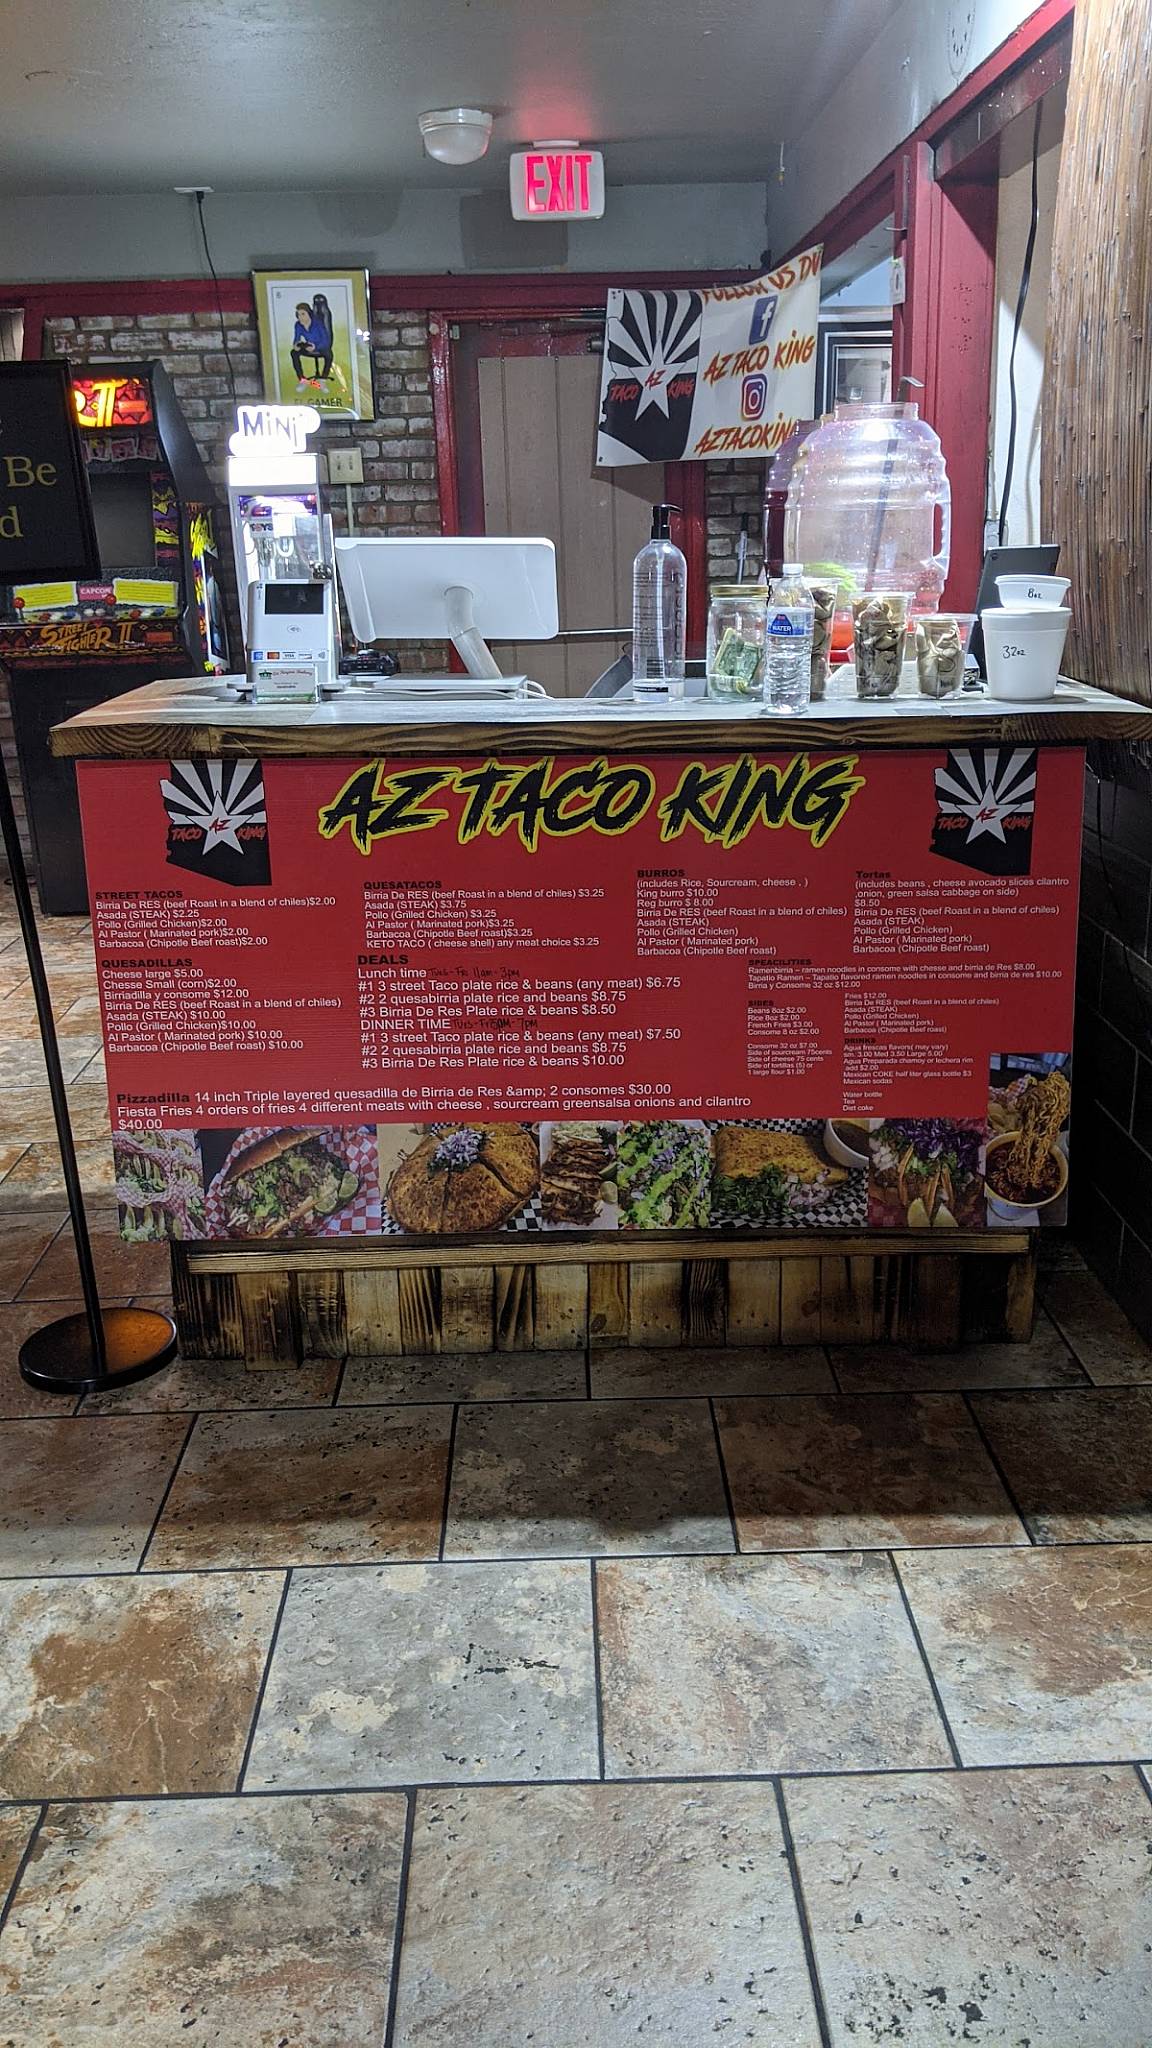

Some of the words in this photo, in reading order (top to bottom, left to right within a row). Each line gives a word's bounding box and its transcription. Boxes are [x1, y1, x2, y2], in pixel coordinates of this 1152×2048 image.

[526, 155, 593, 212] EXIT
[768, 266, 796, 290] US
[703, 352, 732, 387] AZ
[731, 345, 769, 378] TACO
[772, 330, 816, 372] KING
[644, 370, 665, 390] AZ
[610, 383, 639, 401] TACO
[667, 379, 694, 399] KING
[307, 397, 343, 407] GAMER
[694, 413, 797, 456] AZTACOKIN
[3, 456, 57, 488] Be
[319, 757, 462, 855] AZ
[457, 756, 656, 853] TACO
[659, 752, 867, 850] KING
[976, 807, 999, 823] AZ
[208, 818, 231, 833] AZ
[937, 814, 969, 831] TACO
[1002, 813, 1032, 830] KING
[171, 826, 204, 843] TACO
[237, 825, 266, 841] KING
[637, 869, 684, 877] BURROS
[364, 880, 441, 890] QUESATACOS
[96, 891, 139, 900] STREET
[142, 890, 182, 900] TACOS
[637, 888, 657, 899] King
[687, 888, 718, 897] $10.00
[96, 901, 120, 909] Birria
[123, 901, 136, 909] De
[139, 900, 160, 908] RES
[163, 900, 187, 909] (beef
[190, 899, 217, 907] Roast
[239, 898, 264, 906] blend
[268, 898, 276, 906] of
[637, 898, 655, 908] Reg
[685, 898, 690, 906] $
[694, 898, 713, 906] 8.00
[96, 911, 126, 919] Asada
[129, 910, 170, 920] (STEAK)
[173, 909, 199, 918] $2.25
[365, 911, 388, 919] Pollo
[391, 910, 424, 920] (Grilled
[427, 910, 467, 919] Chicken)
[470, 909, 496, 917] $3.25
[97, 920, 121, 928] Pollo
[124, 919, 157, 929] (Grilled
[854, 926, 876, 934] Pollo
[878, 925, 910, 935] (Grilled
[913, 925, 952, 934] Chicken)
[366, 940, 394, 948] KETO
[397, 938, 425, 947] TACO
[428, 939, 430, 948] (
[434, 938, 467, 947] cheese
[470, 938, 494, 948] shell)
[497, 937, 513, 948] any
[541, 938, 570, 946] choice
[573, 937, 598, 945] $3.25
[102, 959, 192, 969] QUESADILLAS
[358, 955, 408, 964] DEALS
[102, 970, 142, 978] Cheese
[145, 969, 170, 979] large
[174, 968, 203, 977] $5.00
[358, 968, 396, 978] Lunch
[400, 967, 426, 977] time
[103, 980, 142, 989] Chesse
[145, 978, 174, 988] Small
[358, 981, 372, 991] #1
[378, 980, 385, 991] 3
[390, 981, 425, 990] street
[428, 980, 457, 990] Taco
[462, 980, 491, 992] plate
[496, 979, 517, 989] rice
[522, 979, 531, 989] &
[535, 979, 572, 989] beans
[577, 978, 603, 990] (any
[607, 977, 642, 990] meat)
[646, 976, 680, 987] $6.75
[104, 990, 151, 999] Birriadilla
[154, 992, 160, 1001] y
[164, 991, 210, 999] consome
[214, 990, 248, 998] $12.00
[360, 1007, 375, 1017] #3
[380, 1004, 411, 1016] Birria
[416, 1006, 433, 1016] De
[438, 1005, 462, 1016] Res
[464, 1004, 497, 1015] Plate
[502, 1005, 523, 1015] rice
[528, 1005, 536, 1015] &
[540, 1004, 577, 1014] beans
[582, 1003, 615, 1014] $8.50
[361, 1019, 413, 1029] DINNER
[417, 1018, 450, 1028] TIME
[116, 1093, 189, 1103] Pizzadilla
[195, 1092, 209, 1102] 14
[214, 1091, 240, 1101] inch
[244, 1090, 279, 1102] Triple
[283, 1089, 330, 1103] layered
[334, 1087, 397, 1103] quesadilla
[402, 1087, 417, 1097] de
[422, 1087, 454, 1098] Birria
[458, 1086, 473, 1096] de
[478, 1086, 501, 1096] Res
[506, 1085, 545, 1098] &amp;
[550, 1086, 557, 1095] 2
[562, 1087, 624, 1096] consomes
[629, 1083, 670, 1096] $30.00
[118, 1120, 162, 1130] $40.00
